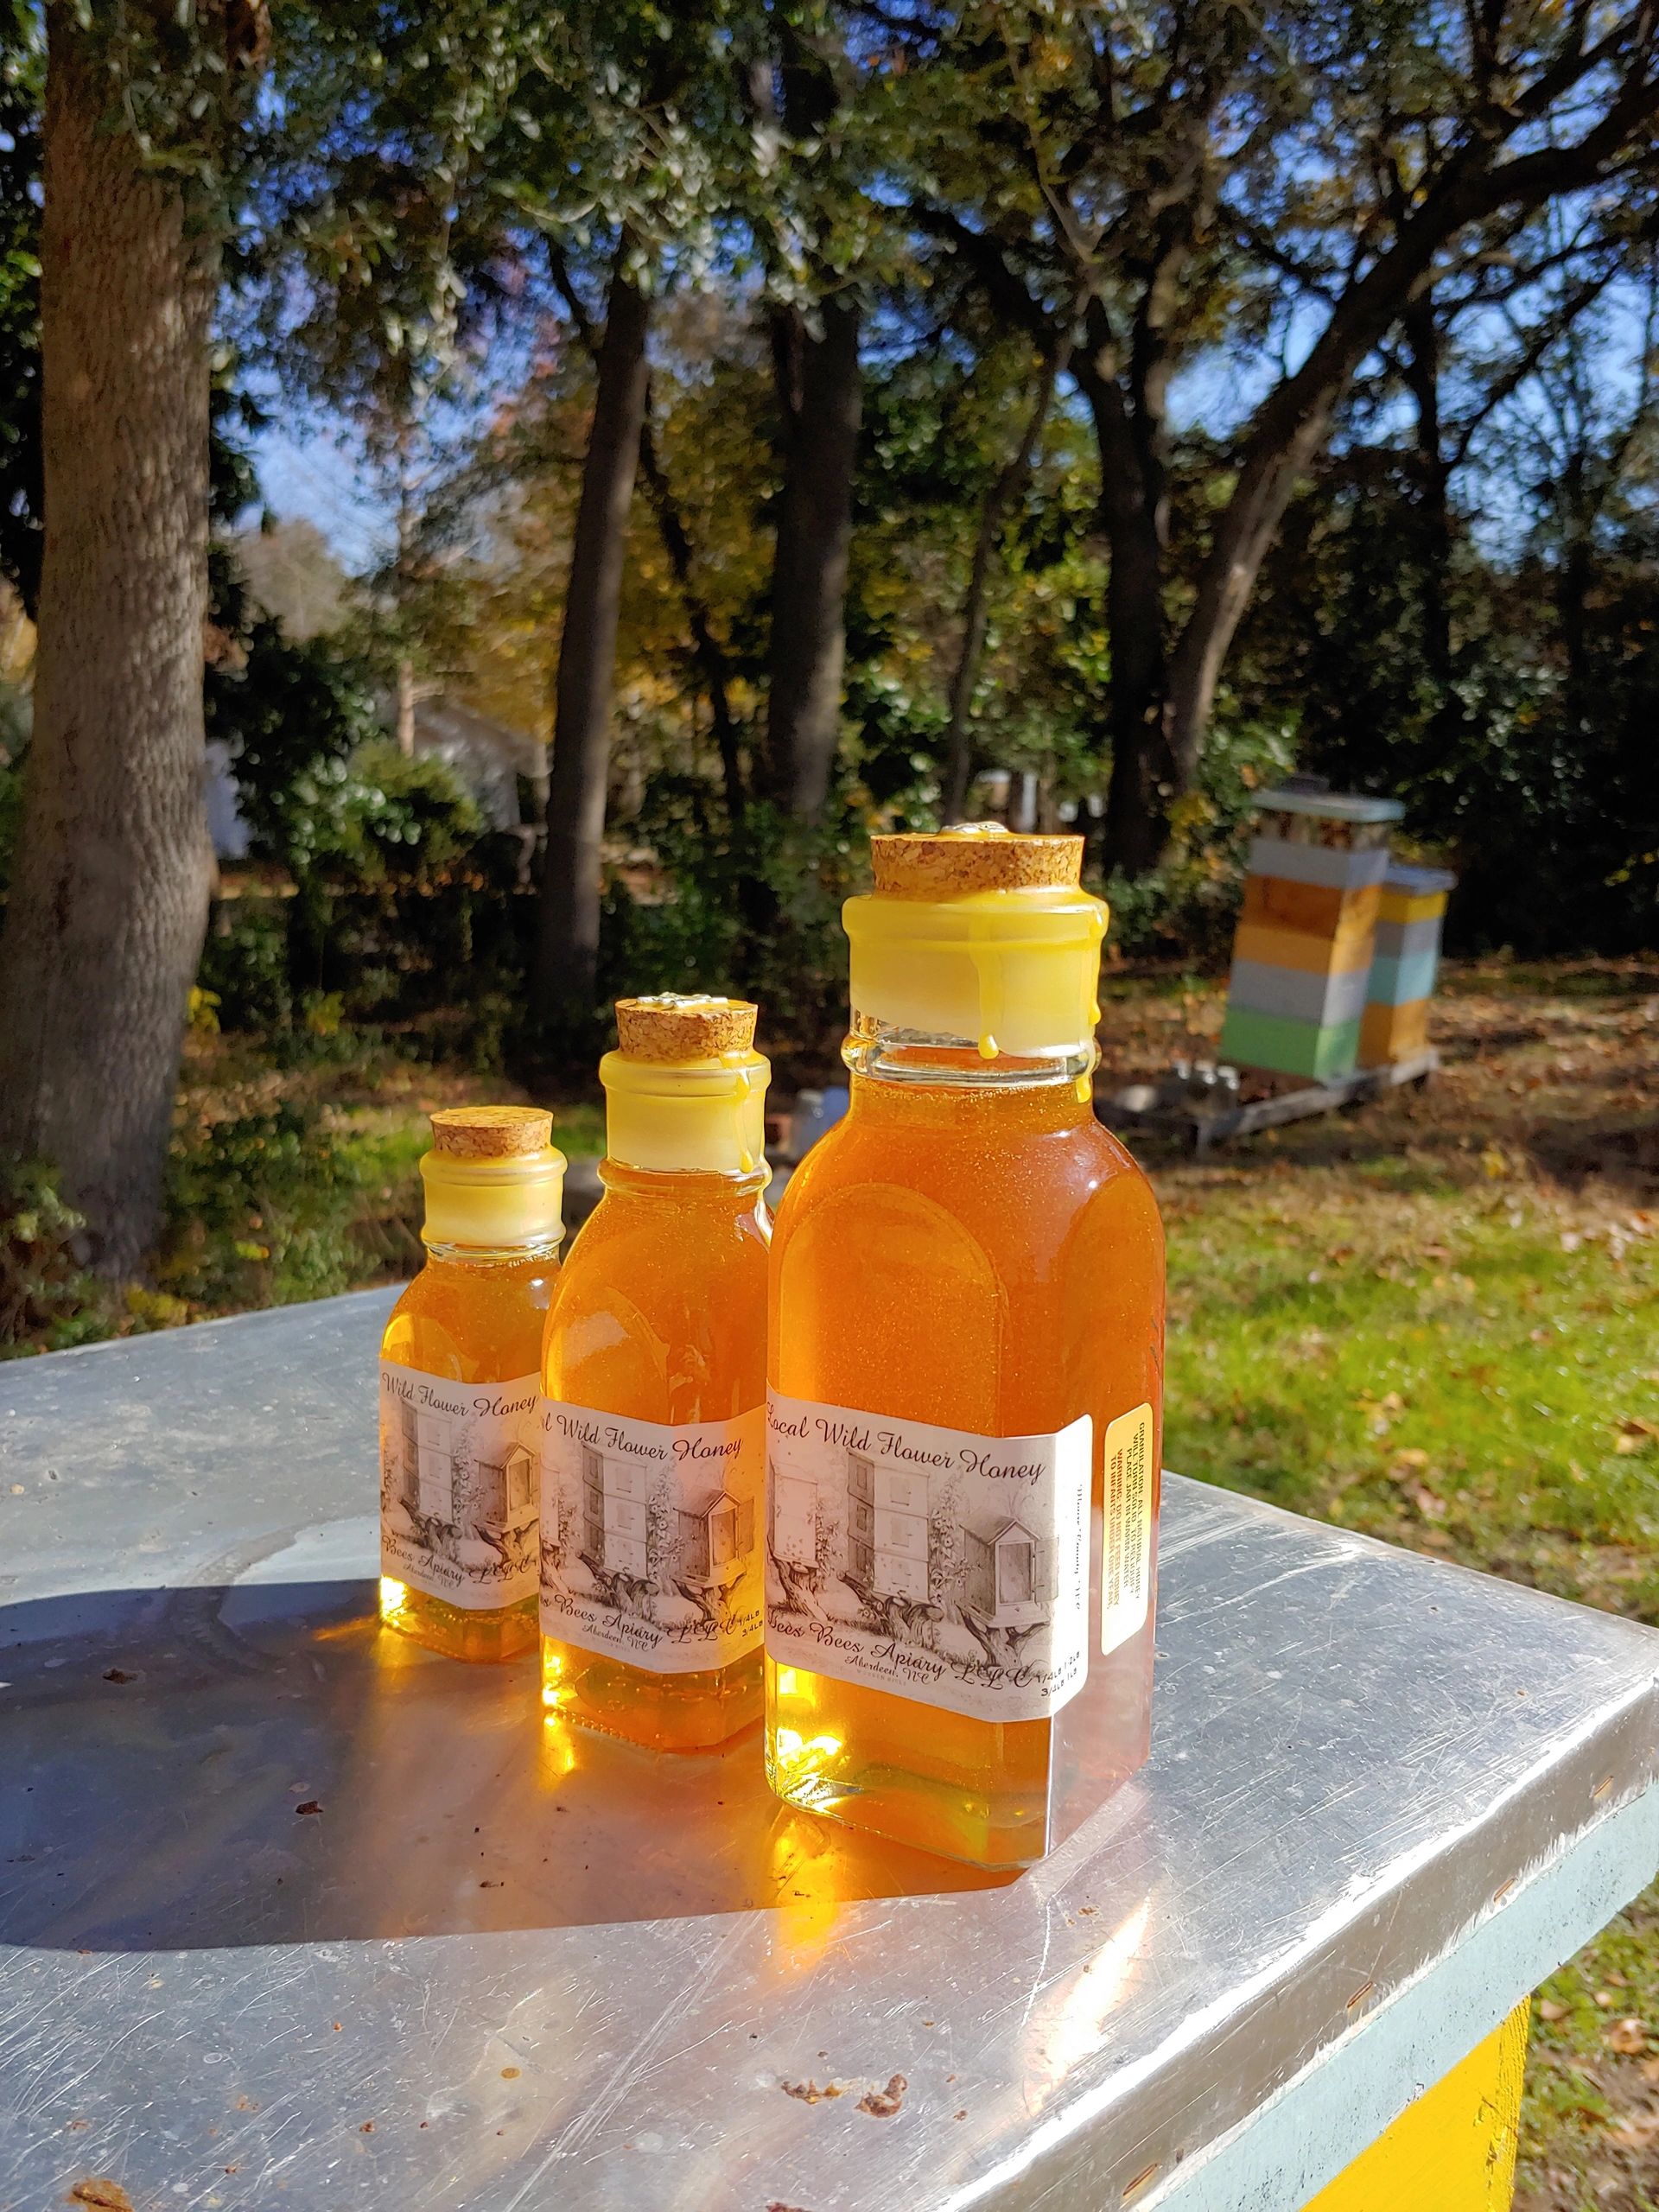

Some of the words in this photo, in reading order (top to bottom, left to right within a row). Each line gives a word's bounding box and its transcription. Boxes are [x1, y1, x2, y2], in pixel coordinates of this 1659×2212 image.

[382, 1372, 415, 1401] Wild
[418, 1385, 469, 1416] Flower
[474, 1396, 538, 1417] Honey
[556, 1414, 601, 1445] Wild
[605, 1427, 668, 1460] Flower
[672, 1437, 743, 1461] Honey
[767, 1401, 810, 1439] Local
[815, 1418, 872, 1452] Wild
[877, 1431, 955, 1470] Flower
[959, 1448, 1046, 1486] Honey
[382, 1535, 413, 1562] Bees
[418, 1555, 465, 1588] Apiary
[554, 1594, 598, 1623] Bees
[602, 1613, 663, 1649] Apiary
[626, 1636, 649, 1653] NC
[809, 1622, 865, 1653] Bees
[870, 1643, 947, 1681] Apiary
[902, 1667, 931, 1686] NC
